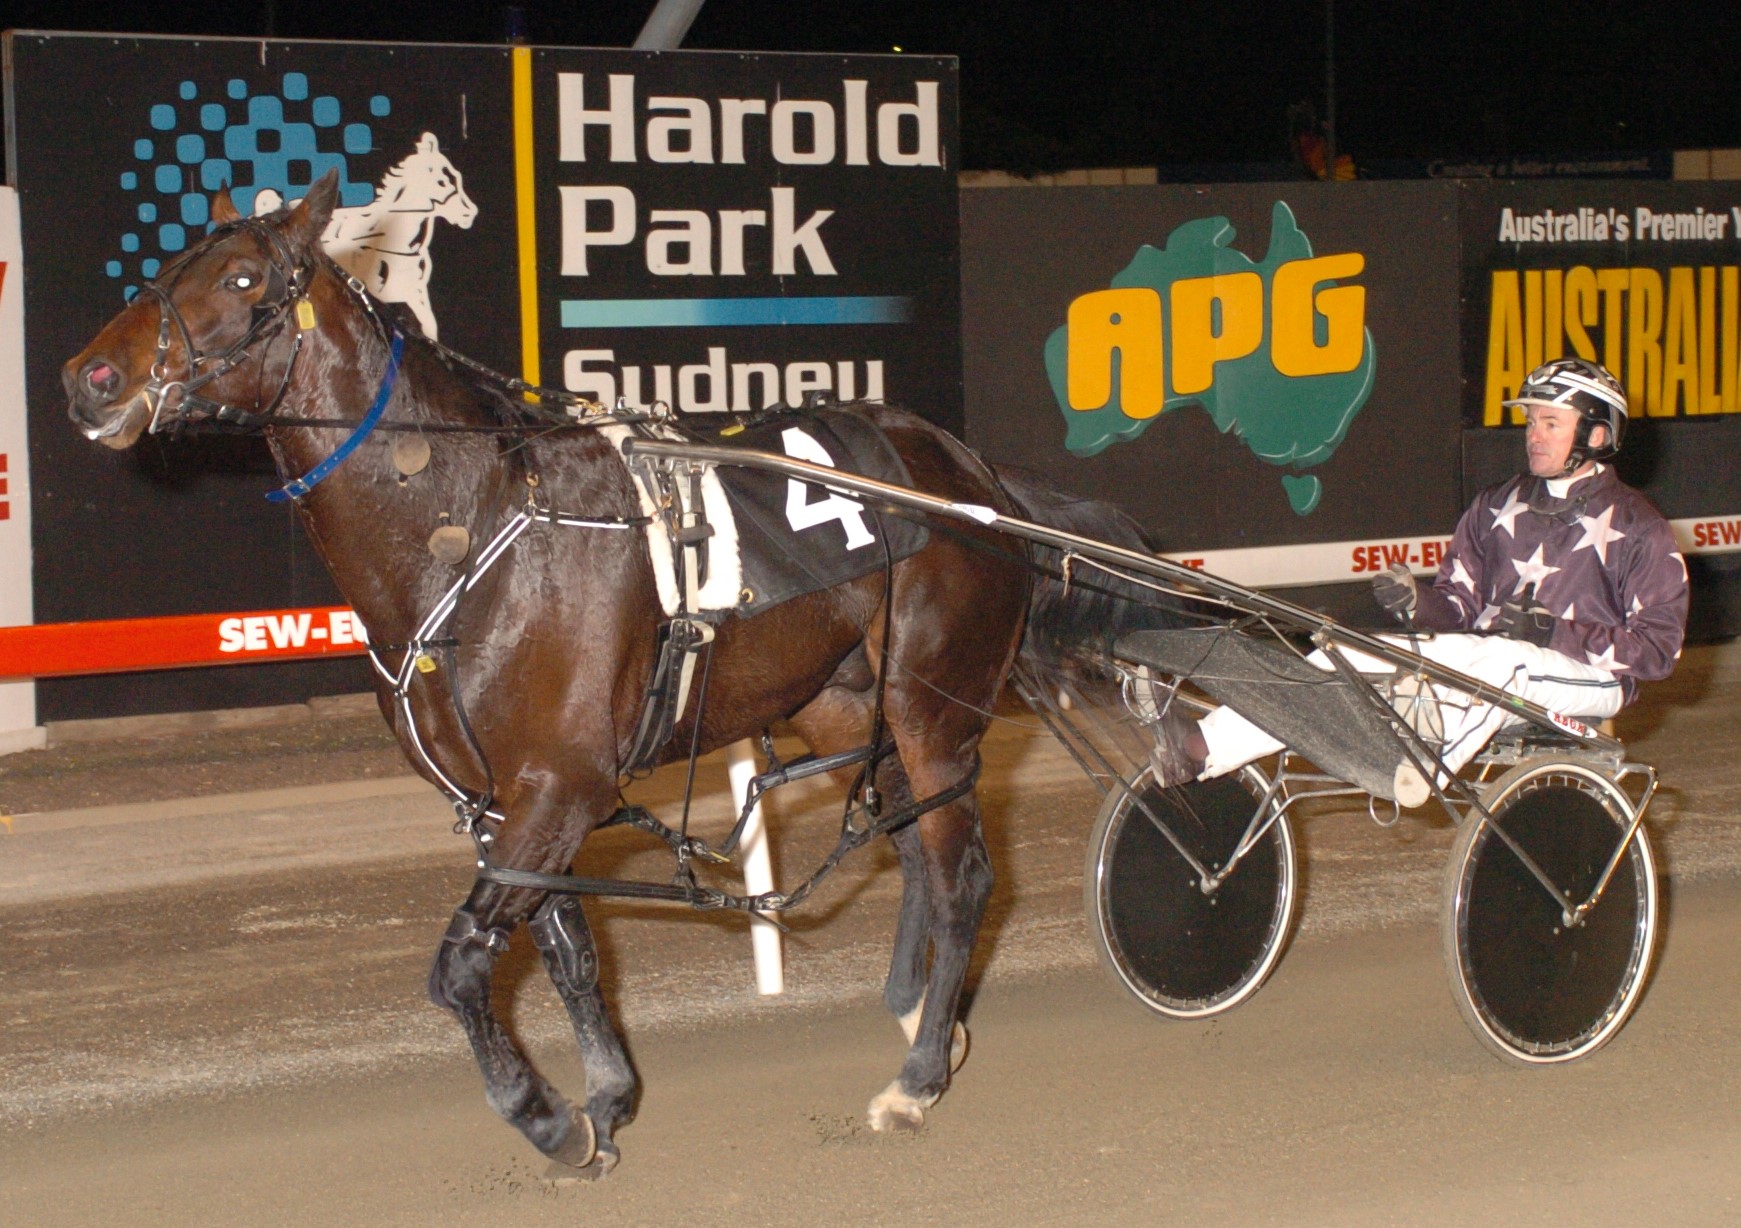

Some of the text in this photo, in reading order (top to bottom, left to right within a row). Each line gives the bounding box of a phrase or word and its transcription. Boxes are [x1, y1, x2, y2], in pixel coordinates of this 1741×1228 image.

[557, 72, 942, 167] Harold
[558, 185, 839, 277] Park
[1498, 207, 1630, 242] Australia's
[1635, 206, 1729, 241] Premier
[563, 347, 885, 416] Sydney
[1067, 252, 1366, 420] APG
[781, 426, 875, 551] 4
